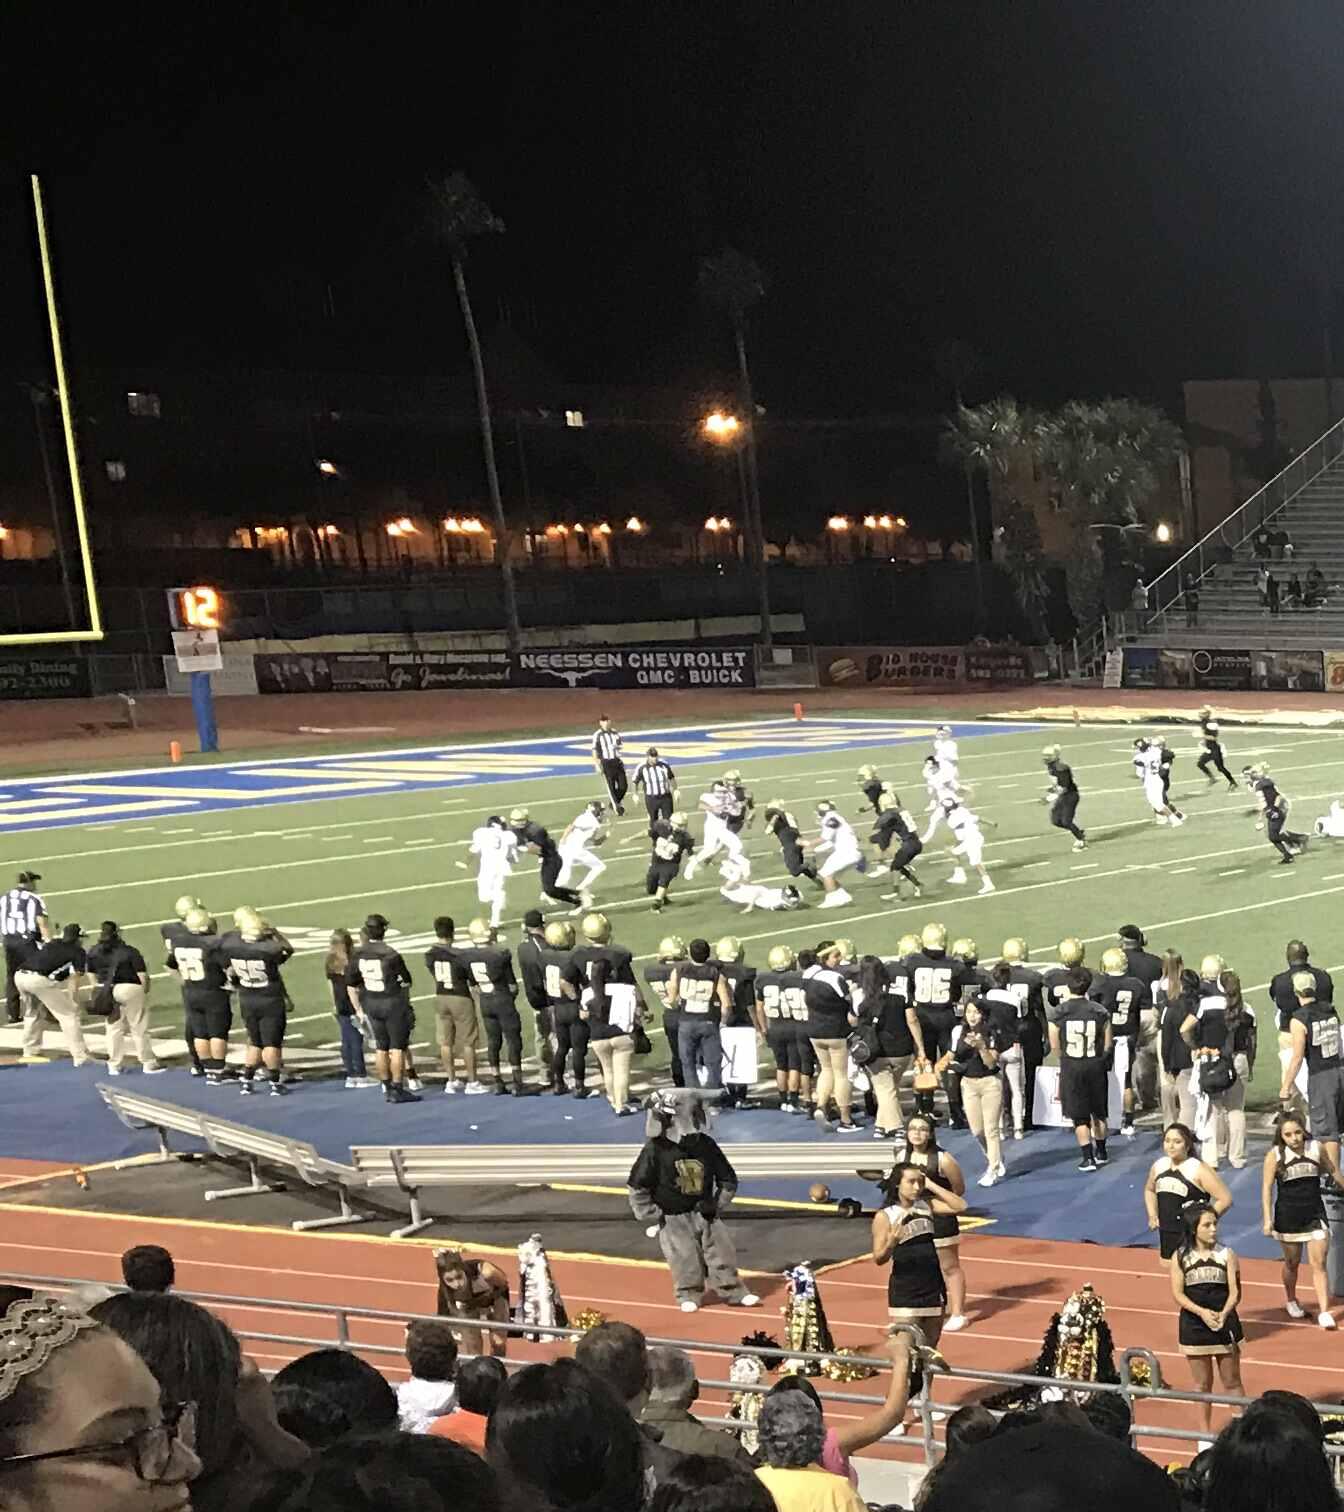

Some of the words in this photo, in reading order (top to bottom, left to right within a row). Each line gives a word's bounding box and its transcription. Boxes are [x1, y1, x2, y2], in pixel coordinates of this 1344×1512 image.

[183, 586, 221, 627] 12
[520, 653, 622, 668] NEESSEN
[628, 652, 746, 668] CHEVROLET
[636, 670, 675, 684] GMC
[690, 670, 743, 683] BUICK
[866, 666, 956, 681] BURGERS
[1111, 990, 1132, 1025] 3
[1065, 1020, 1097, 1058] 51
